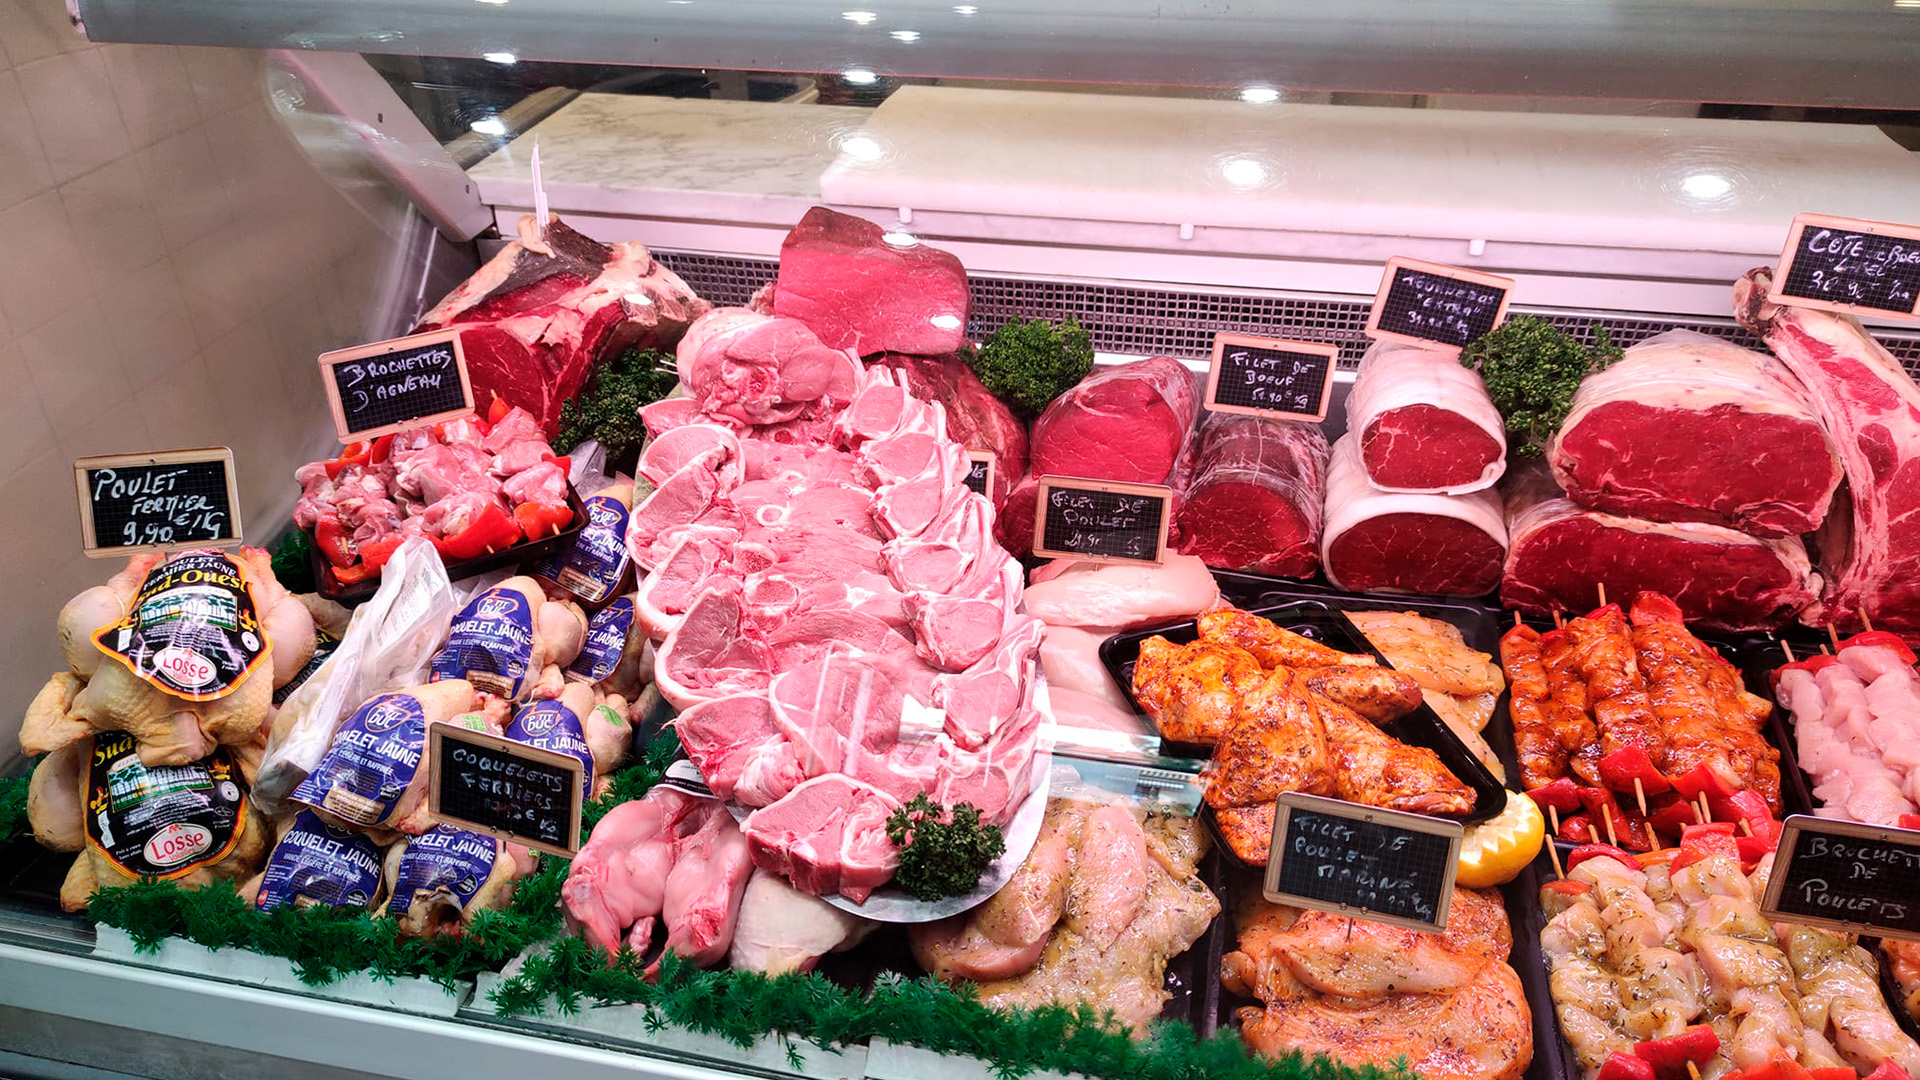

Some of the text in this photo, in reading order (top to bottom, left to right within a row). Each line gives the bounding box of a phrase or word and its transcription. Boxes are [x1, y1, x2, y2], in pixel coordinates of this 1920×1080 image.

[343, 350, 452, 388] BROCHETTES
[1245, 370, 1295, 386] BOEUF
[352, 374, 442, 413] D'AGNEAU
[94, 468, 189, 501] POULET
[376, 738, 421, 769] JAUNE
[551, 737, 589, 754] JAUNE
[452, 748, 563, 793] COQUELETS
[283, 830, 344, 857] COQUELET
[341, 848, 382, 879] JAUNE
[452, 840, 495, 864] JAUNE
